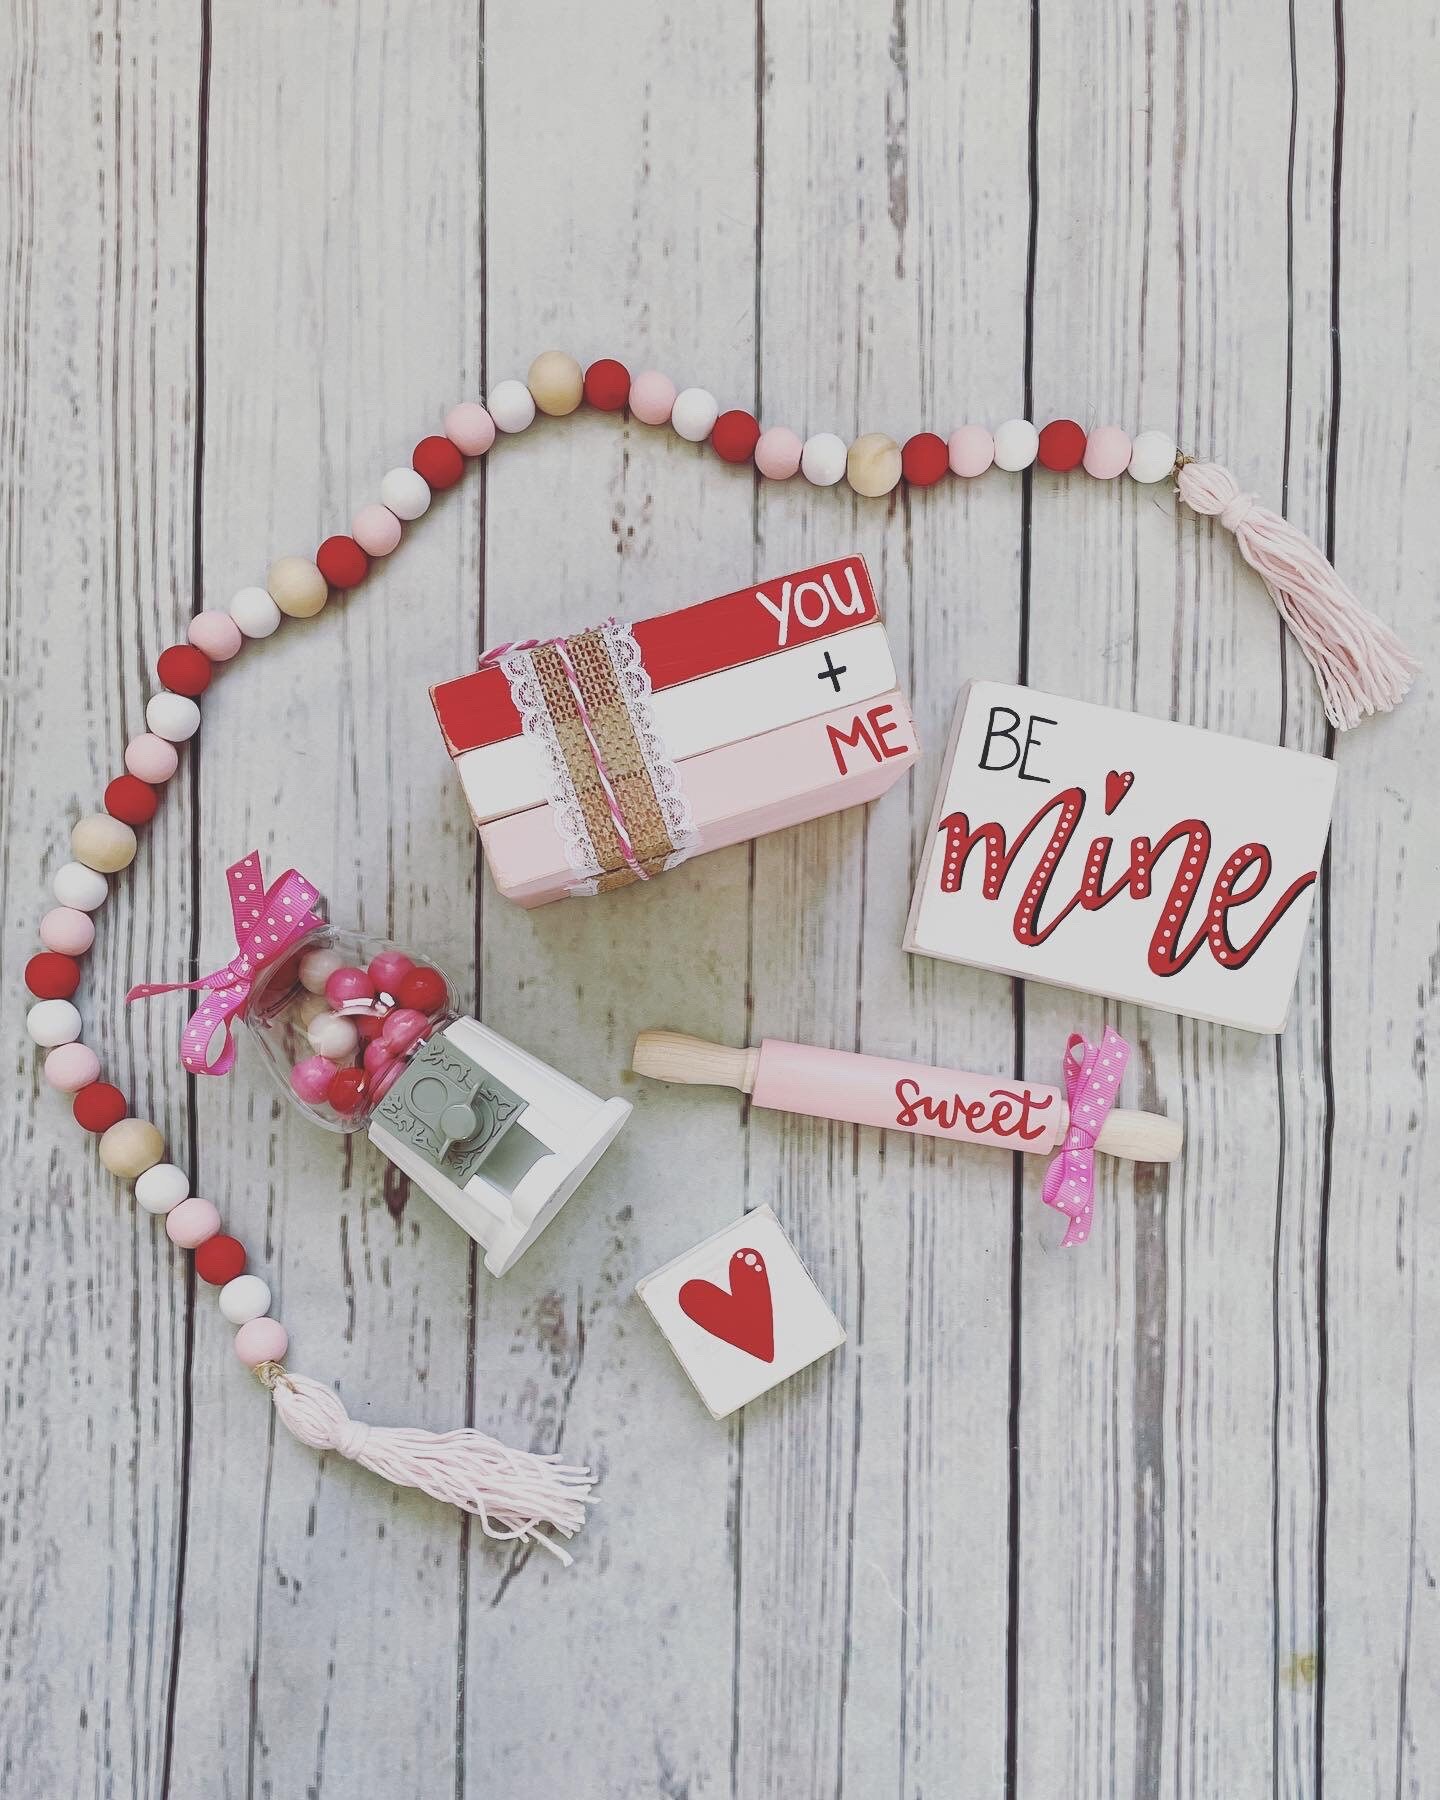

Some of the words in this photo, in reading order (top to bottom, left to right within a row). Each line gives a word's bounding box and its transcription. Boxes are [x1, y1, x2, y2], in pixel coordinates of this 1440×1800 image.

[755, 566, 866, 646] YOU
[817, 651, 847, 692] +
[826, 704, 908, 775] ME
[978, 706, 1058, 783] BE
